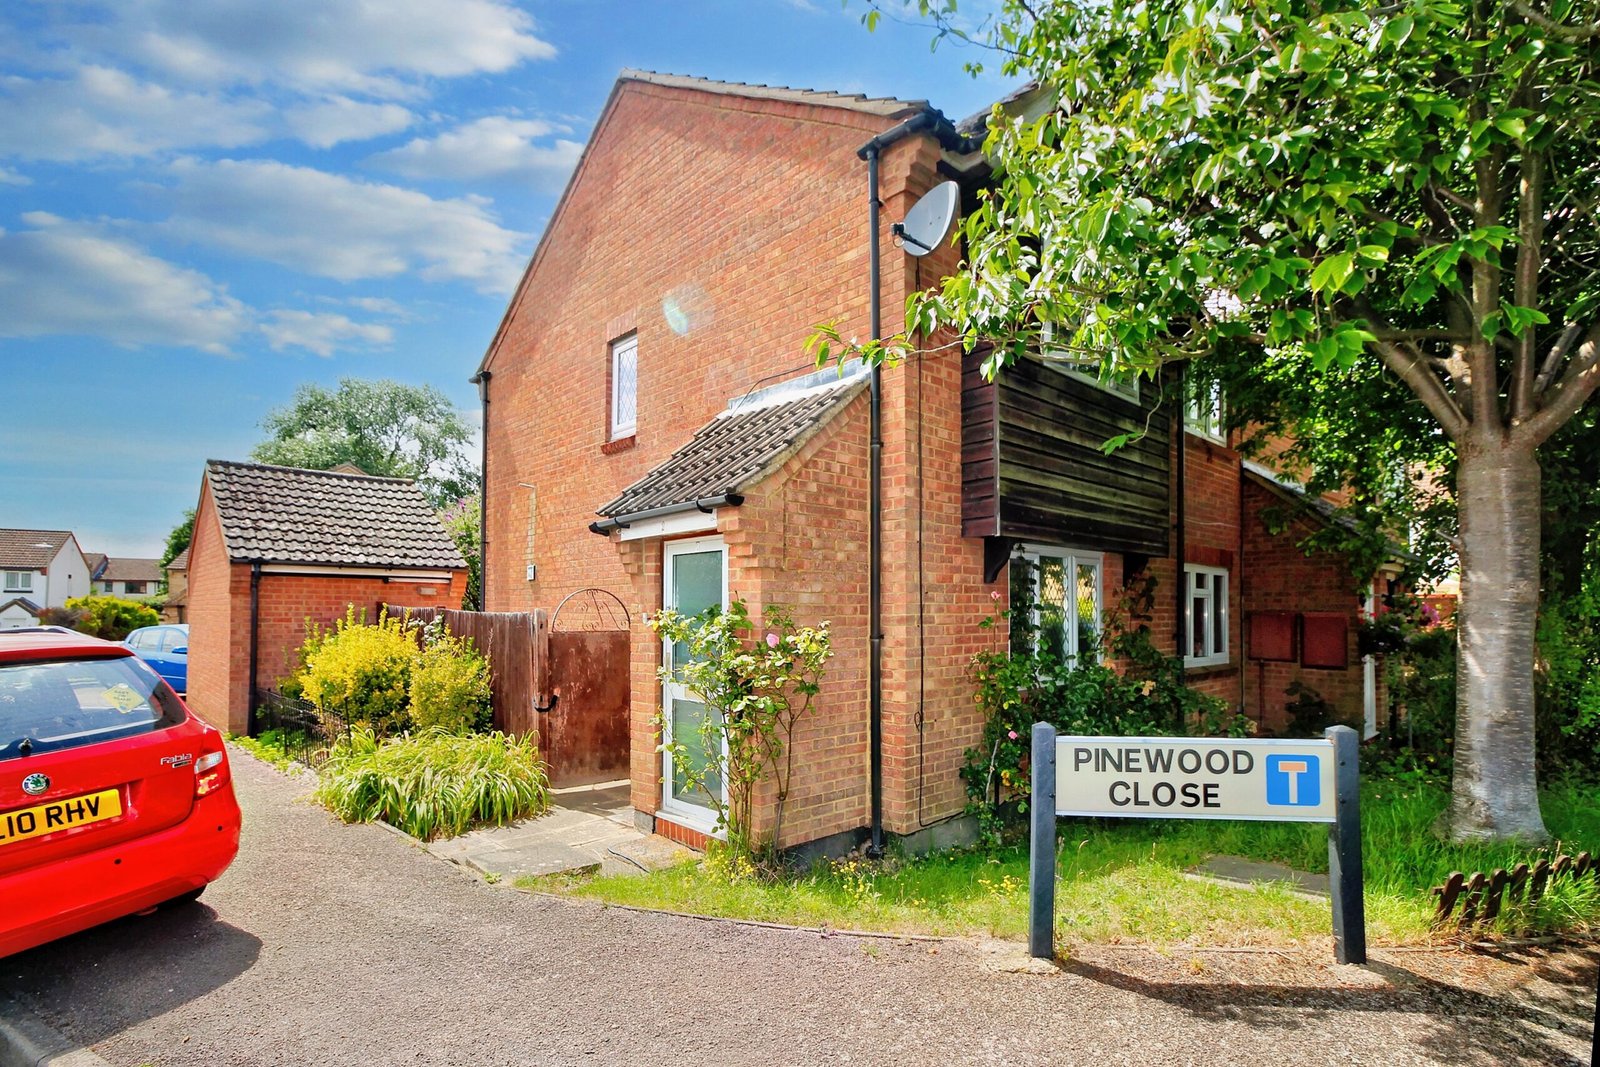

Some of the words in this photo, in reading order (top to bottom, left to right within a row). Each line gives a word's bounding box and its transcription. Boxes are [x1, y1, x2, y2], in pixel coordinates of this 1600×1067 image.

[160, 753, 192, 765] Fabia
[1073, 747, 1254, 775] PINEWOOD
[1108, 780, 1221, 808] CLOSE
[0, 811, 36, 839] 10
[45, 796, 100, 828] RHV
